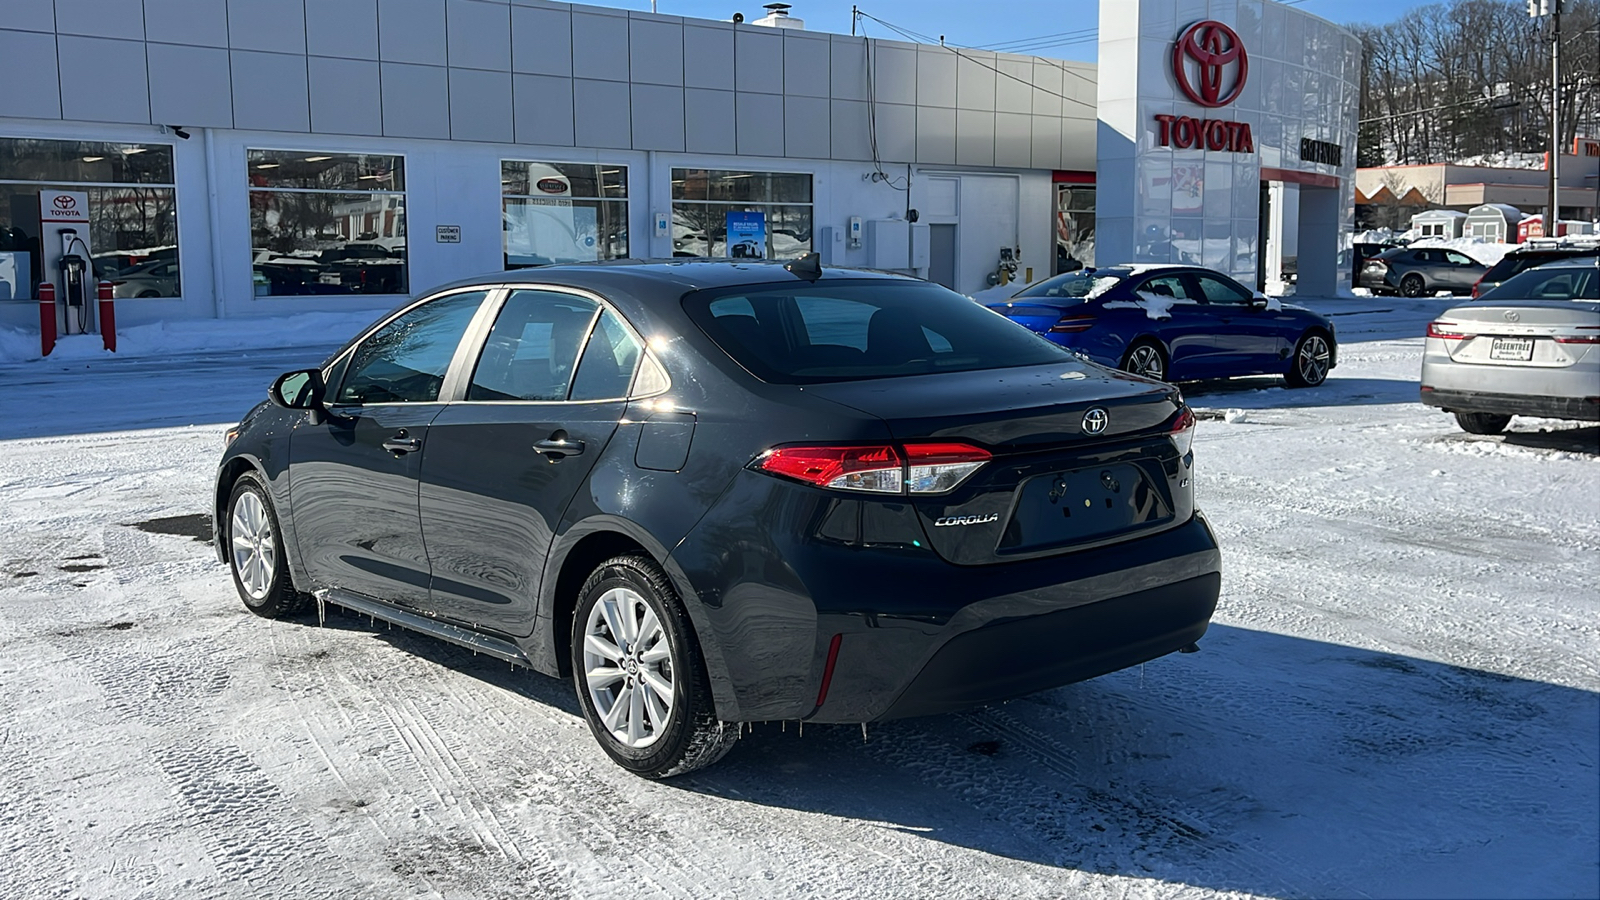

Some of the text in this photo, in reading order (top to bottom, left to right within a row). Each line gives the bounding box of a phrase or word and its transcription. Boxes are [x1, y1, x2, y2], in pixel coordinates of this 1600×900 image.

[1155, 114, 1254, 153] TOYOTA
[1494, 342, 1531, 351] GREENTREE
[934, 512, 999, 527] COROLLA
